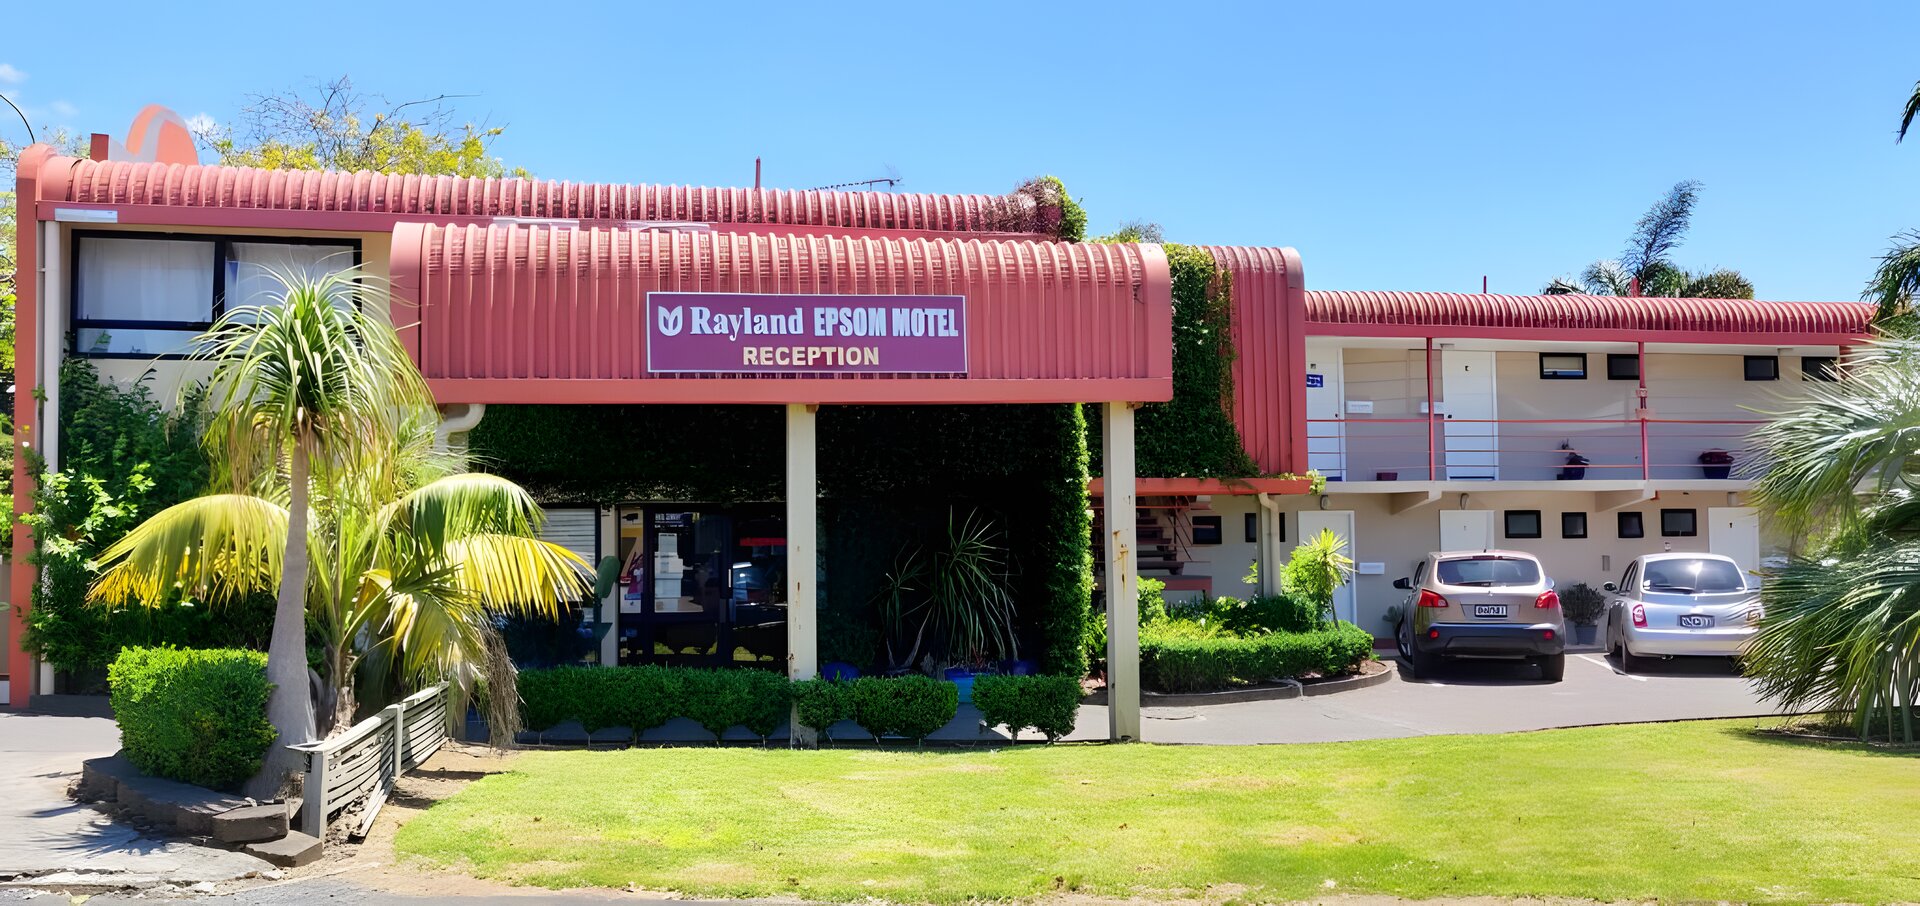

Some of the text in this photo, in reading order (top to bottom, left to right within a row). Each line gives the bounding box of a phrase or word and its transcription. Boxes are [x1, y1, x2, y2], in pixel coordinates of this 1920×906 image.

[690, 306, 959, 341] Rayland EPSOM MOTEL
[743, 346, 879, 366] RECEPTION
